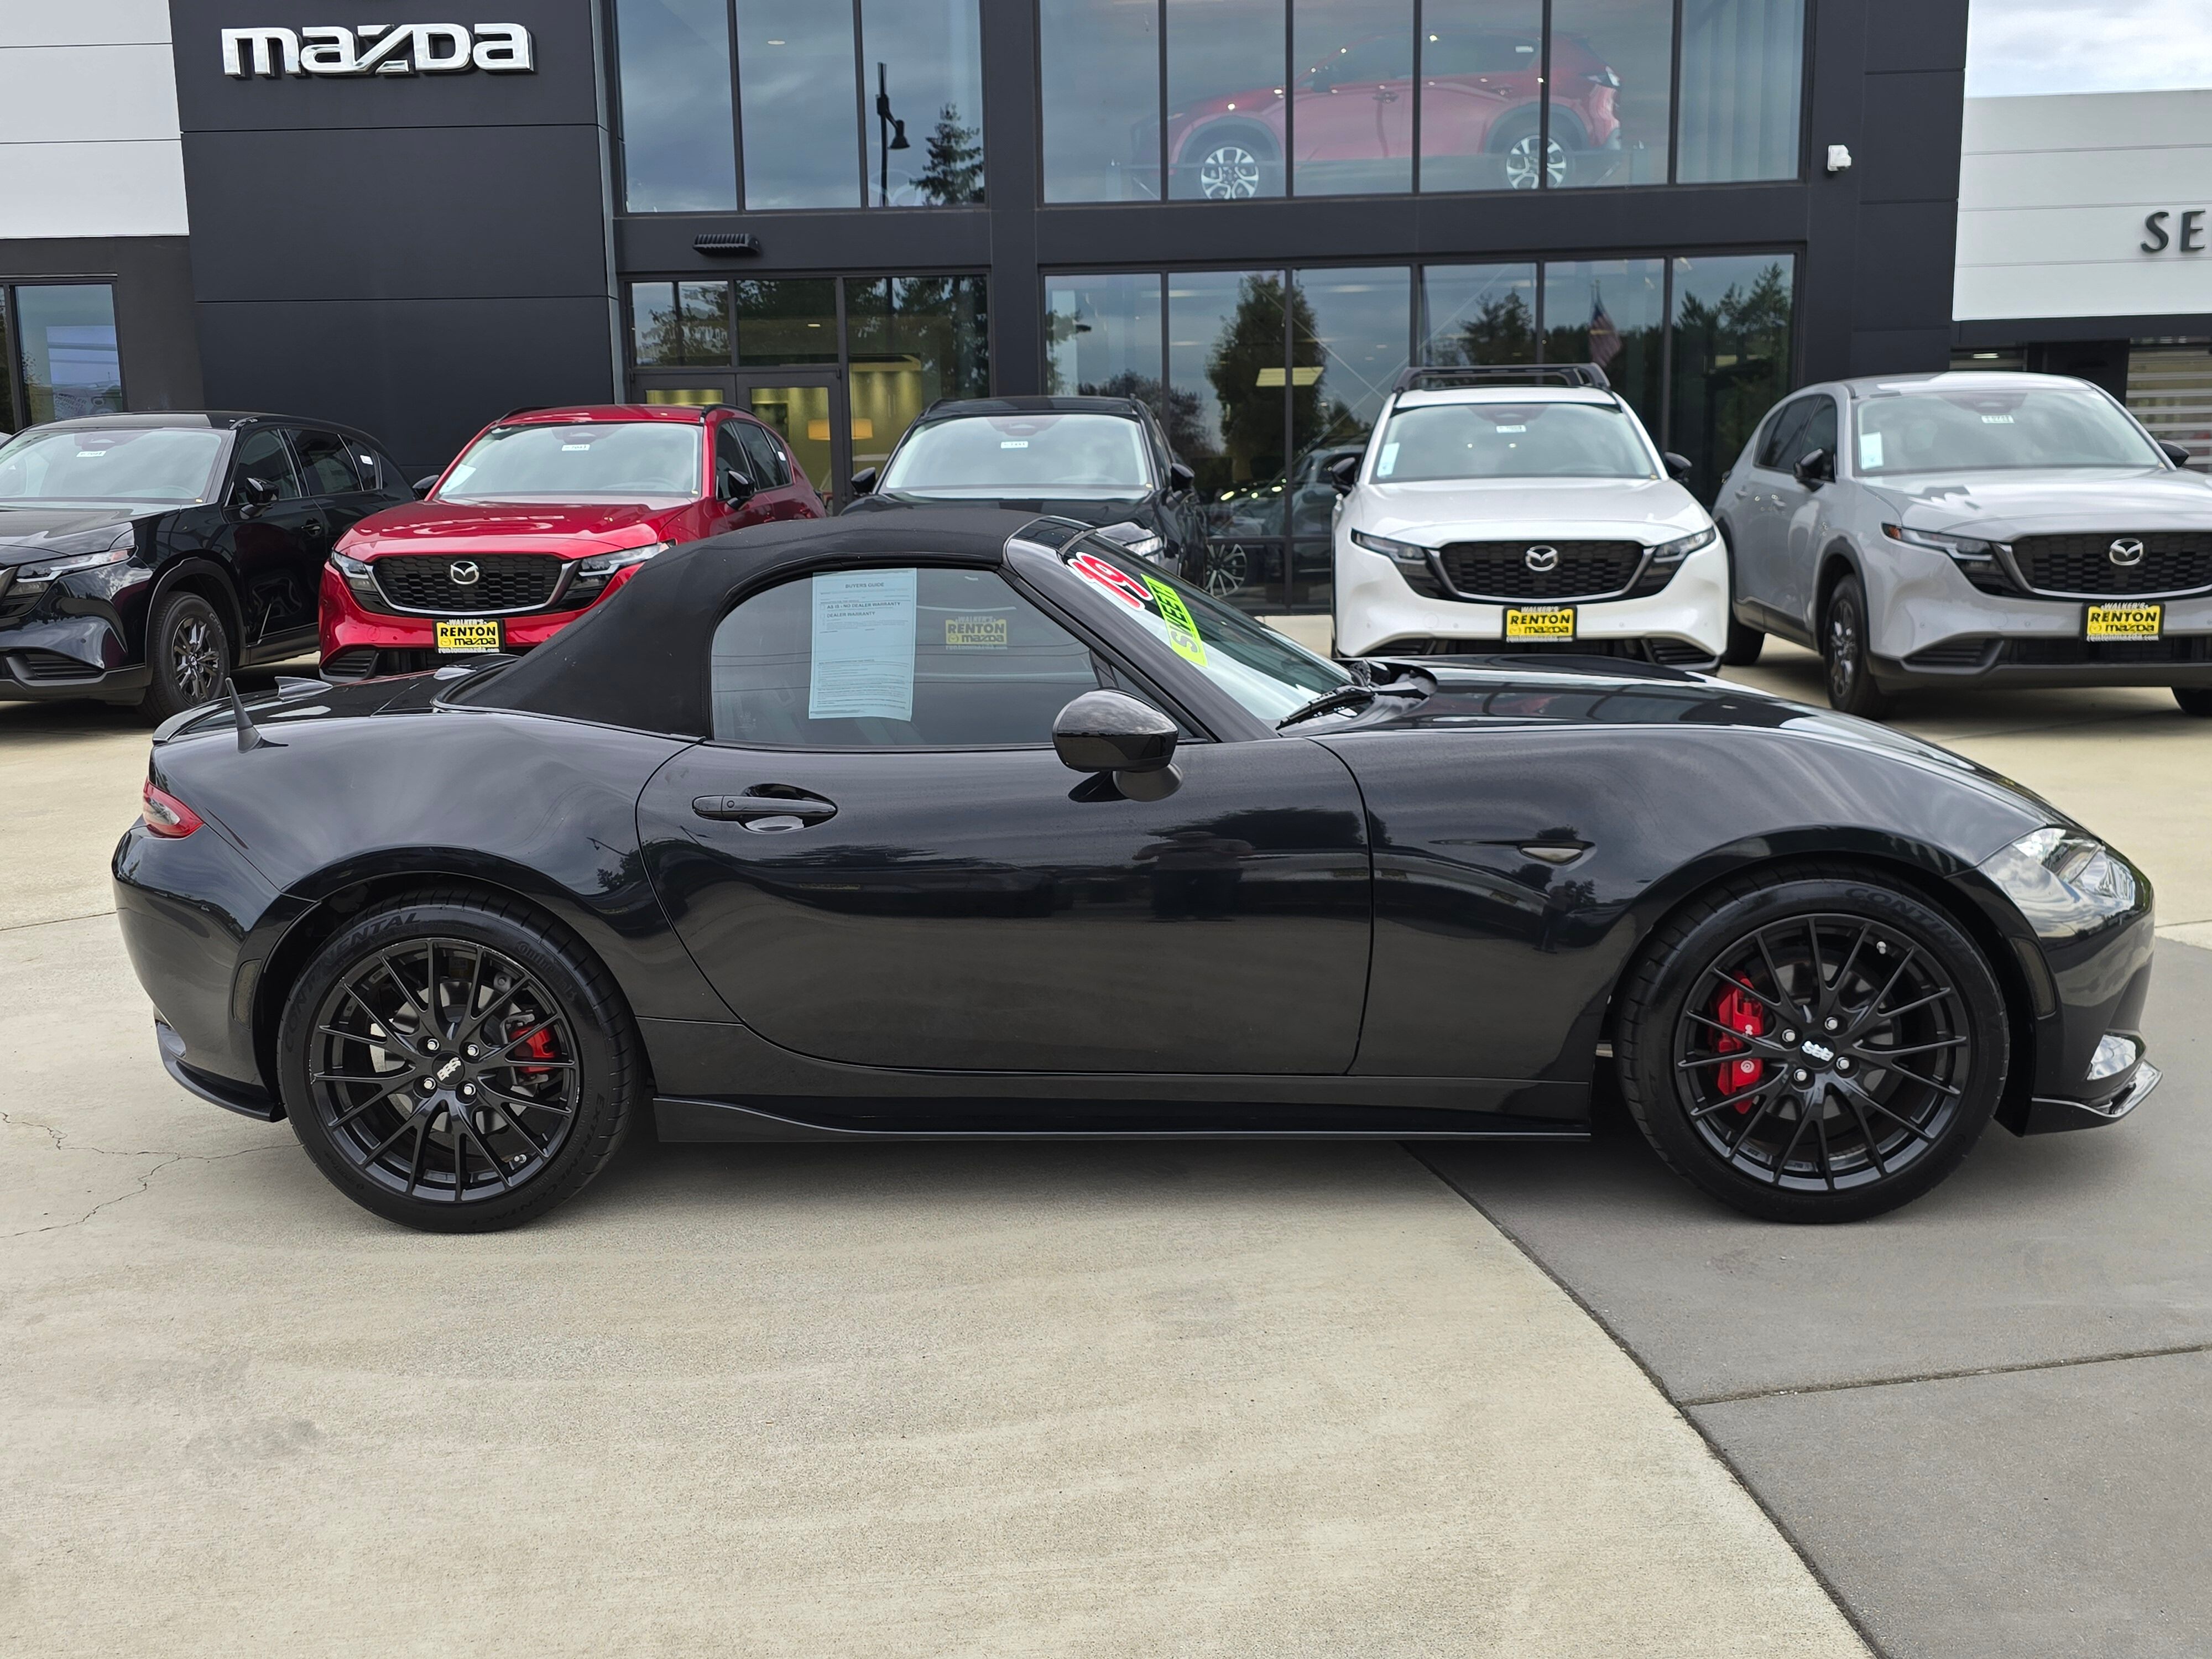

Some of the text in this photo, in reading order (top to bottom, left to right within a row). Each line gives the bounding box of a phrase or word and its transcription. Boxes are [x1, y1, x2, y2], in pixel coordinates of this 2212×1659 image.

[2140, 209, 2206, 253] SE
[1068, 552, 1153, 611] 19
[1510, 614, 1570, 624] RENTON
[2090, 612, 2157, 622] RENTON
[440, 627, 496, 637] RENTON
[947, 623, 1005, 634] RENTON
[437, 1057, 461, 1081] BBS
